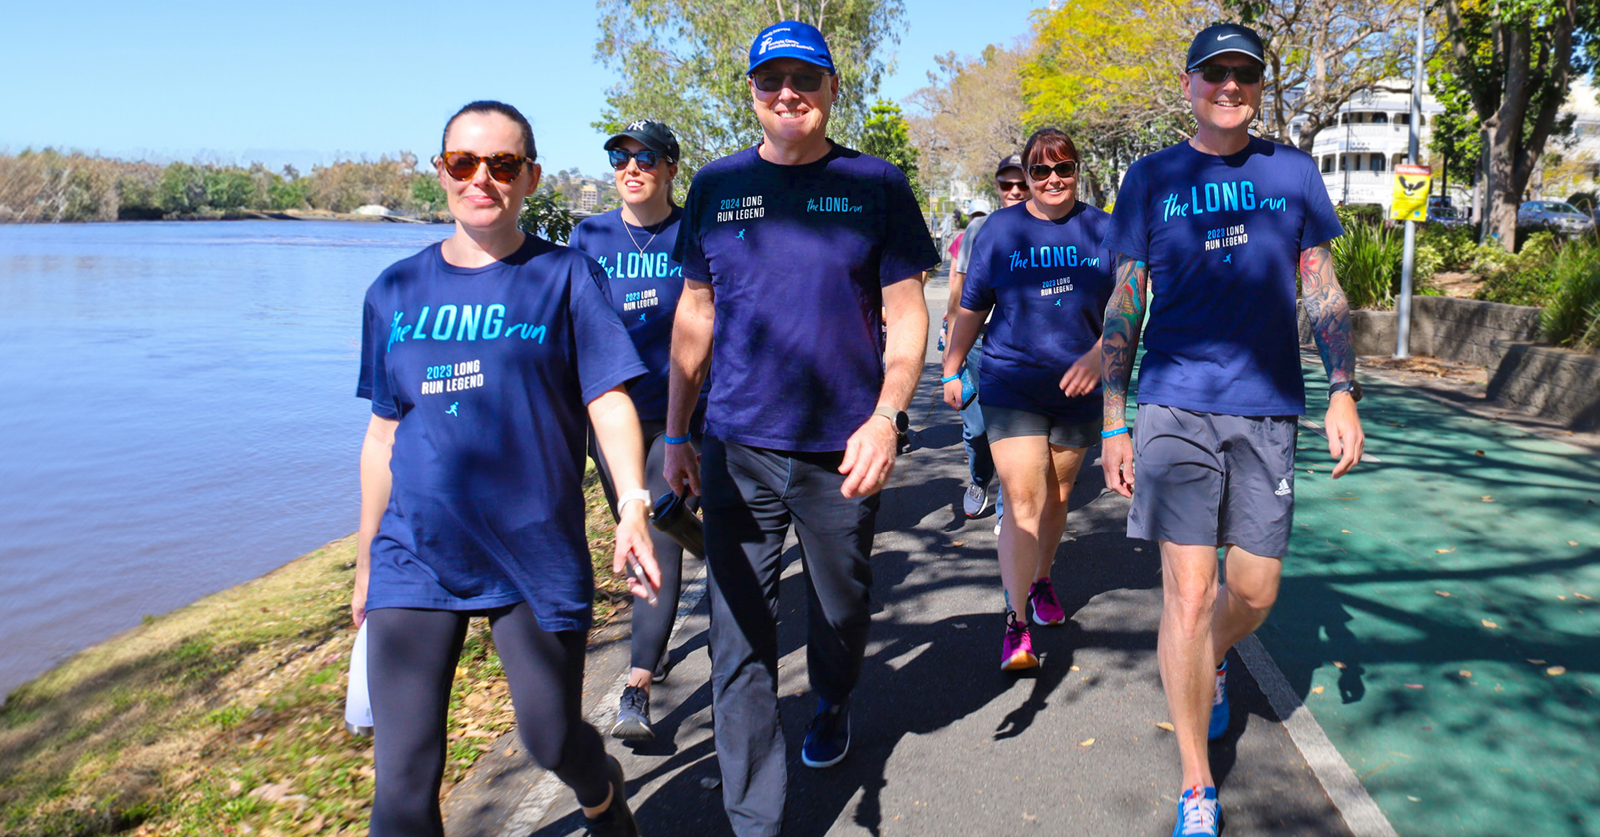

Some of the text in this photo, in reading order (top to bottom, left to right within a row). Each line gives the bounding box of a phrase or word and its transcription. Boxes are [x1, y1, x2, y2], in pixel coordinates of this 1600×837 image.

[720, 196, 762, 210] 2024 LONG
[807, 196, 863, 213] the LONG run
[1163, 180, 1286, 222] the LONG run
[717, 207, 764, 222] RUN LEGEND
[1207, 224, 1244, 240] 2023 LONG
[1205, 234, 1248, 251] RUN LEGEND
[616, 252, 668, 278] LONG
[1009, 246, 1100, 272] the LONG run
[1041, 284, 1074, 296] RUN LEGEND
[1042, 276, 1070, 288] 2023 LONG
[626, 288, 656, 302] 2023 LONG
[624, 297, 658, 312] RUN LEGEND
[387, 303, 547, 354] the LONG run
[426, 359, 480, 380] 2023 LONG
[421, 373, 484, 394] RUN LEGEND
